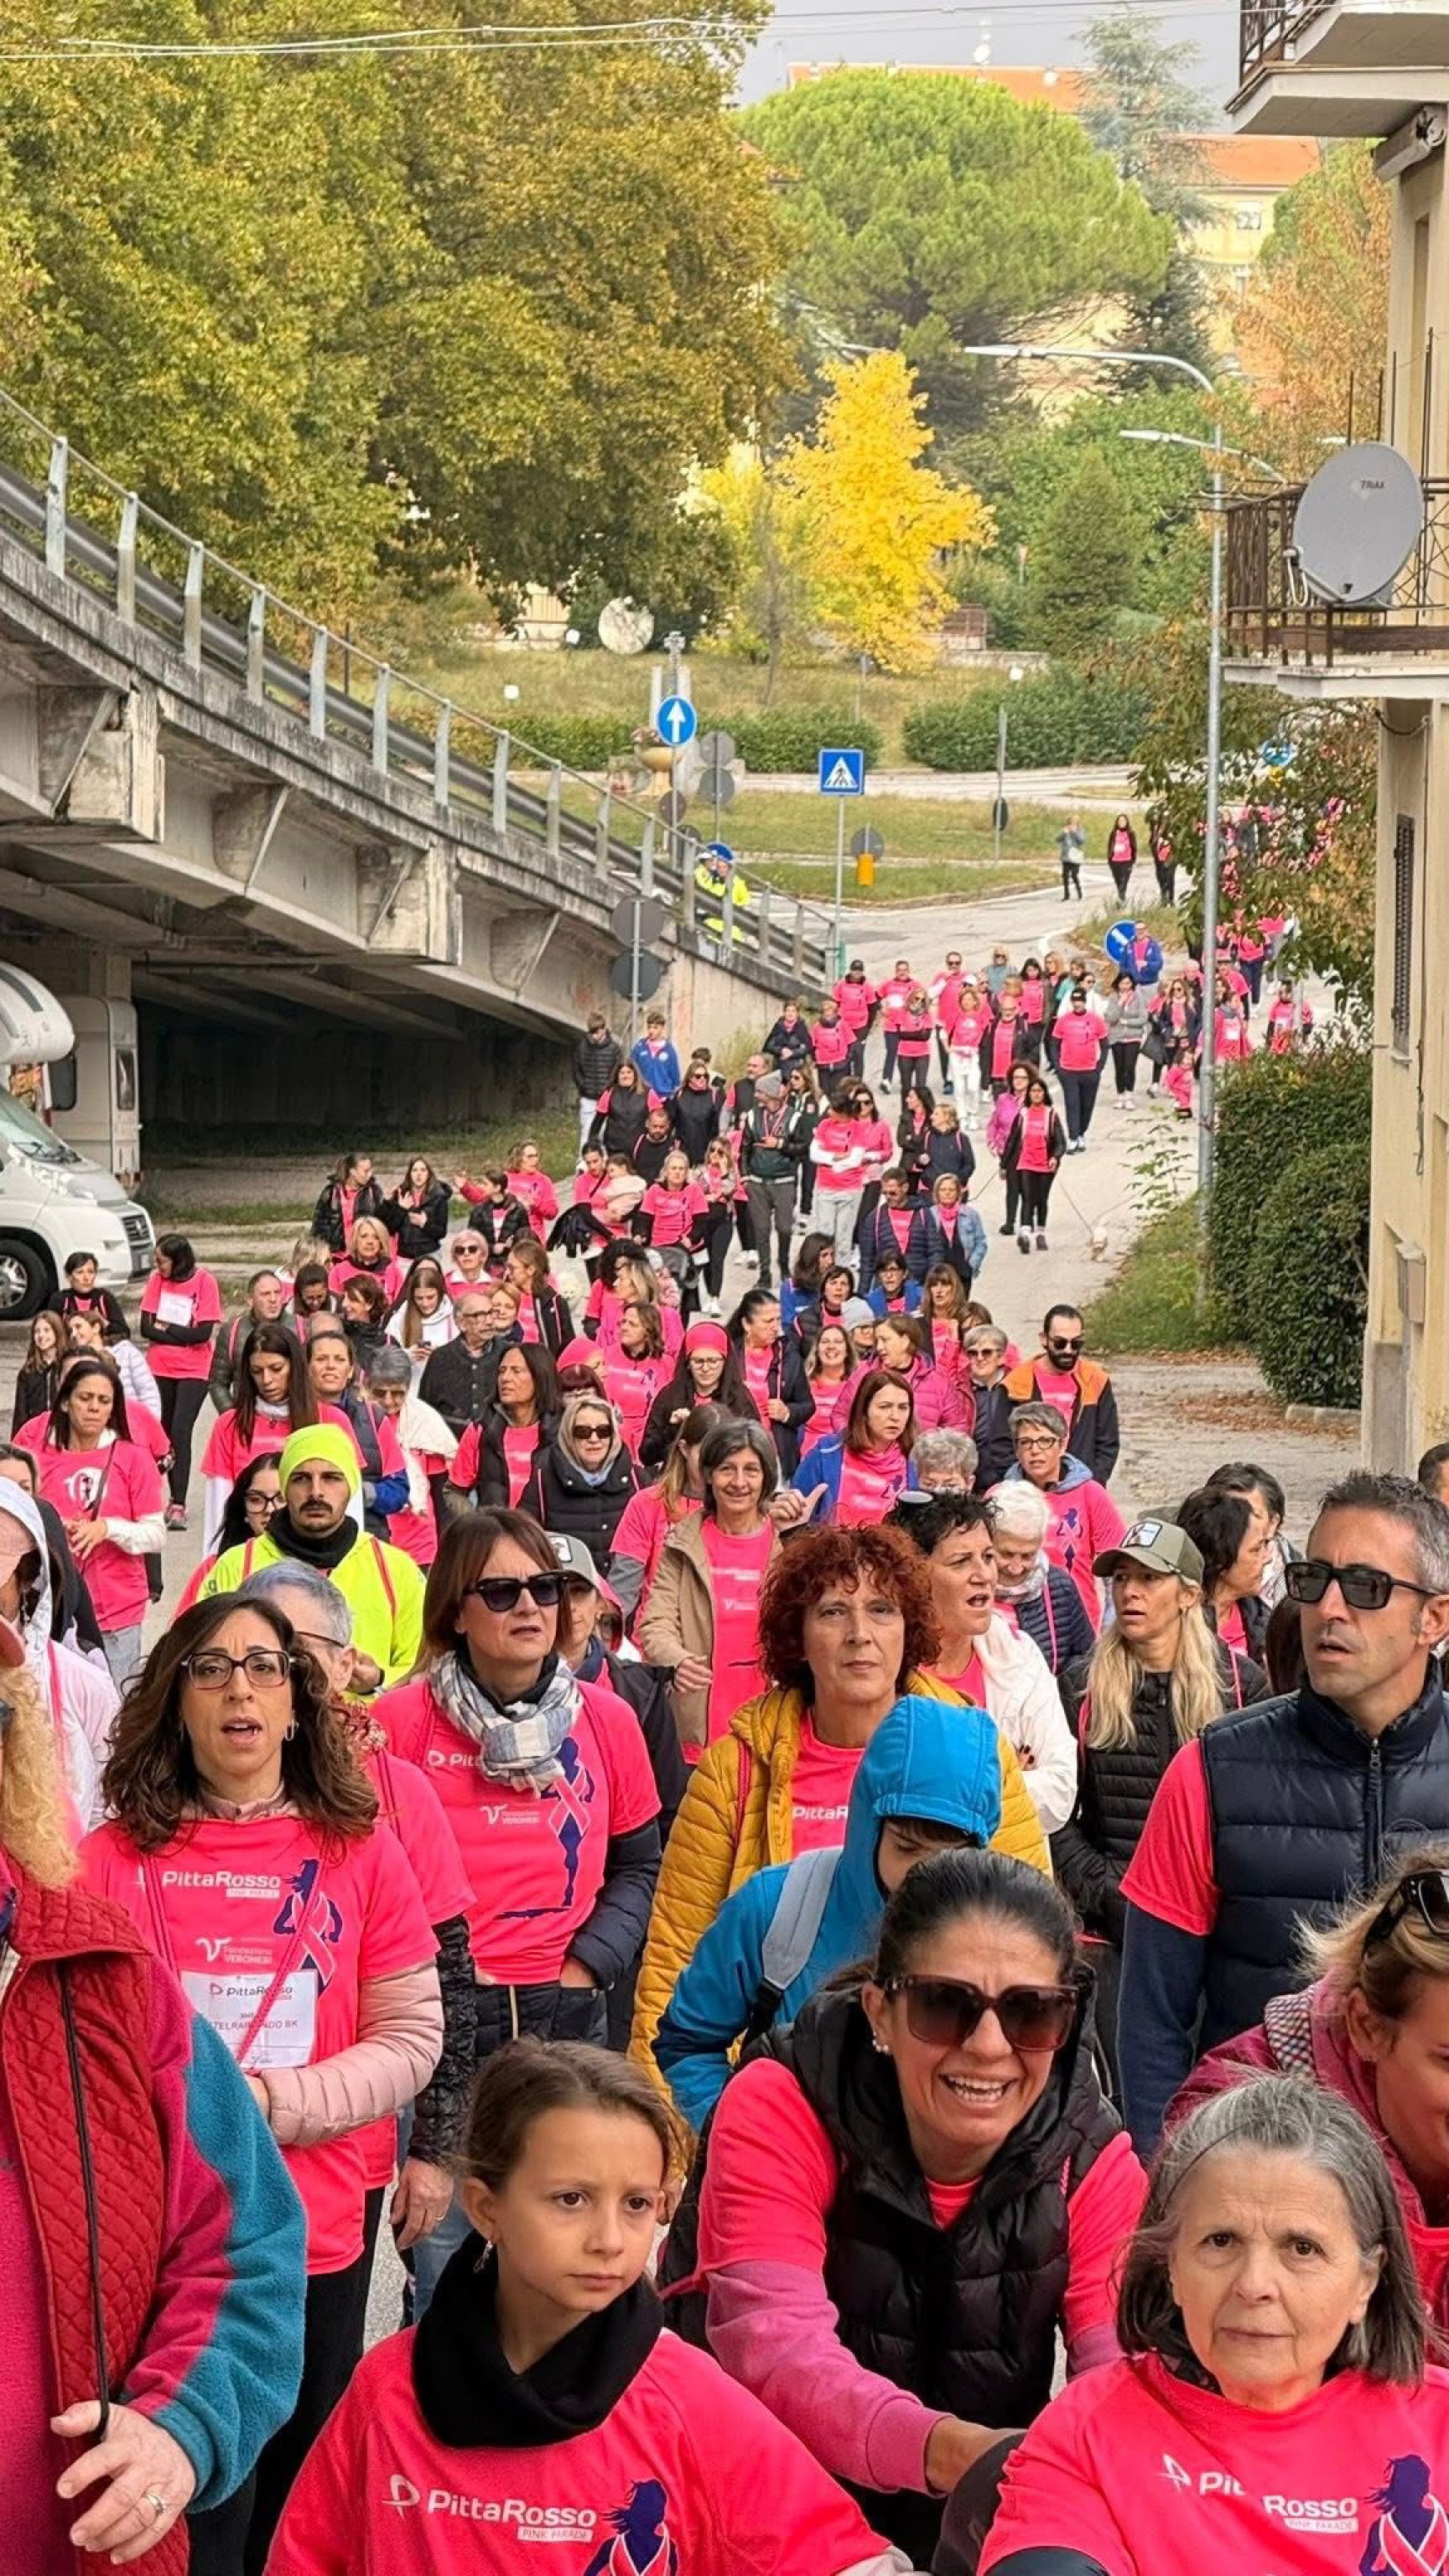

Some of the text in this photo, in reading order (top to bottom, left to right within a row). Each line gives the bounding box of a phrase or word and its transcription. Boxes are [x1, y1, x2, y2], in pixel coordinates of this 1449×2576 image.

[162, 1871, 281, 1888] PittaRosso
[428, 2489, 597, 2527] PittaRosso
[522, 2528, 545, 2539] PINK
